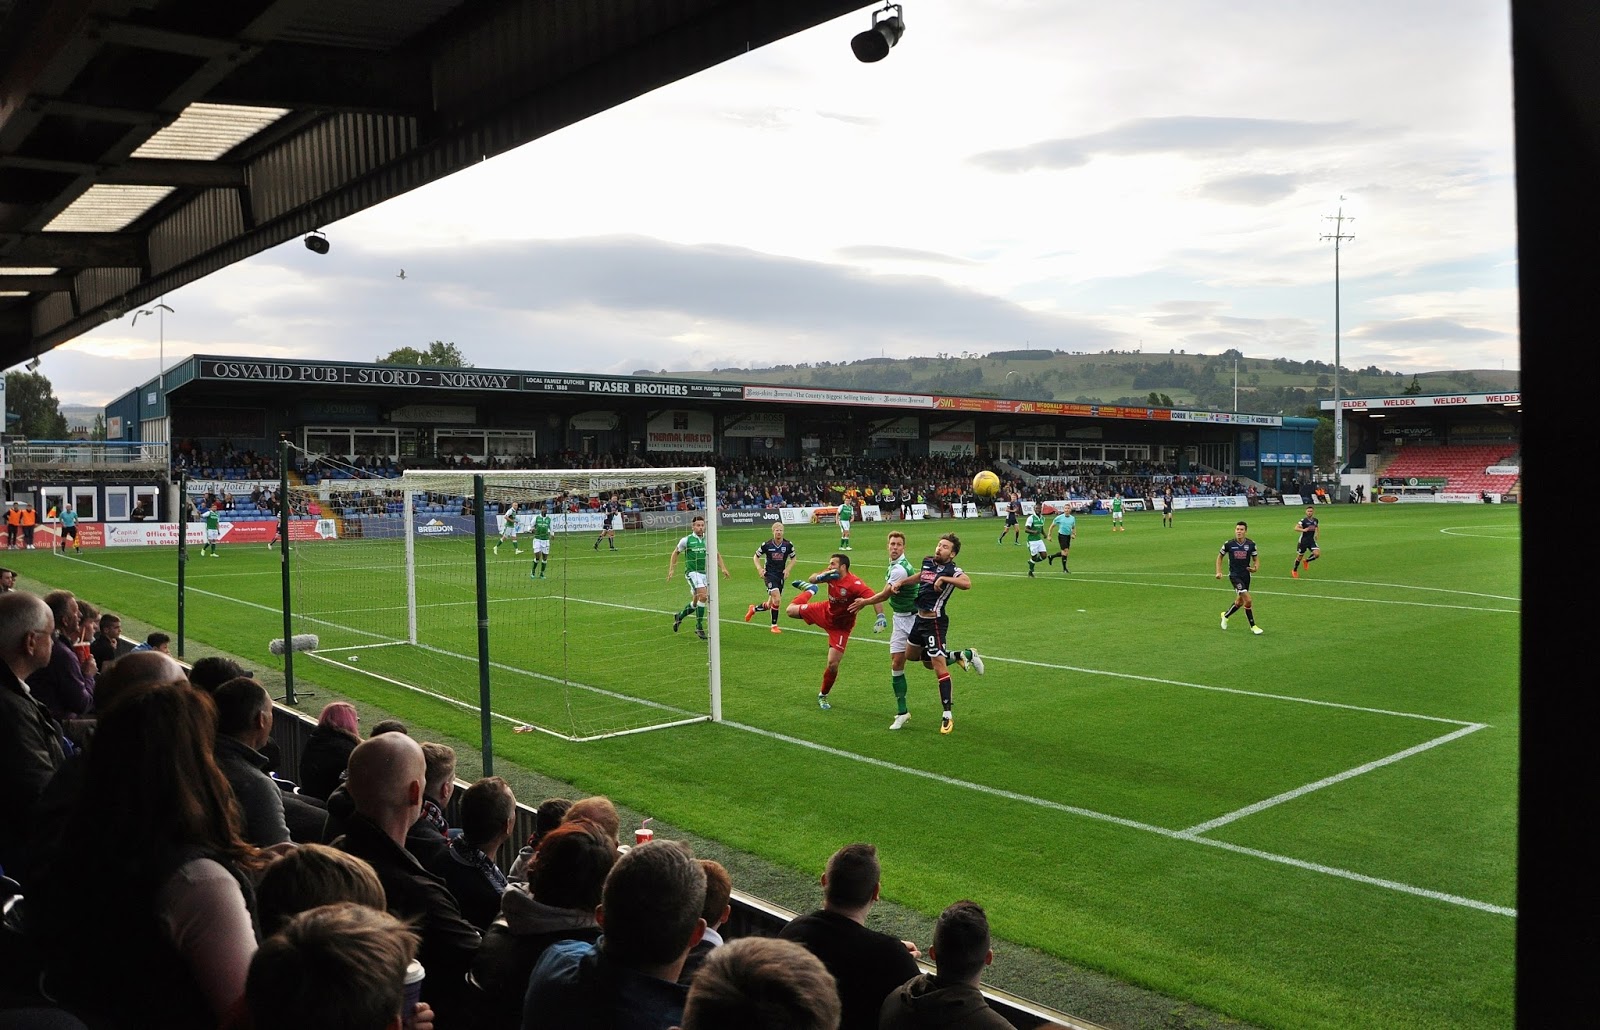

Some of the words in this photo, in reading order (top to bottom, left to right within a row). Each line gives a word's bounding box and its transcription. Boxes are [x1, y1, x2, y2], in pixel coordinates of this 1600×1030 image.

[213, 363, 293, 380] OSVALD
[299, 366, 338, 382] PUB
[358, 369, 420, 385] STORD
[439, 373, 511, 389] NORWAY
[588, 381, 630, 393] FRASER
[634, 383, 688, 396] BROTHERS
[940, 398, 955, 408] SWL
[1383, 399, 1416, 407] WELDEX
[1433, 396, 1468, 405] WELDEX
[1485, 394, 1521, 403] WELDEX
[1020, 403, 1035, 412] SWL
[1341, 400, 1367, 408] ELDEX
[763, 413, 784, 422] ROSS
[648, 432, 682, 443] THERMAL
[683, 433, 700, 443] HIRE
[700, 434, 712, 443] LTD
[223, 482, 246, 490] Hotel
[762, 511, 780, 521] Jeep
[418, 525, 453, 533] BREEDON
[838, 635, 844, 646] 1
[928, 635, 935, 647] 9
